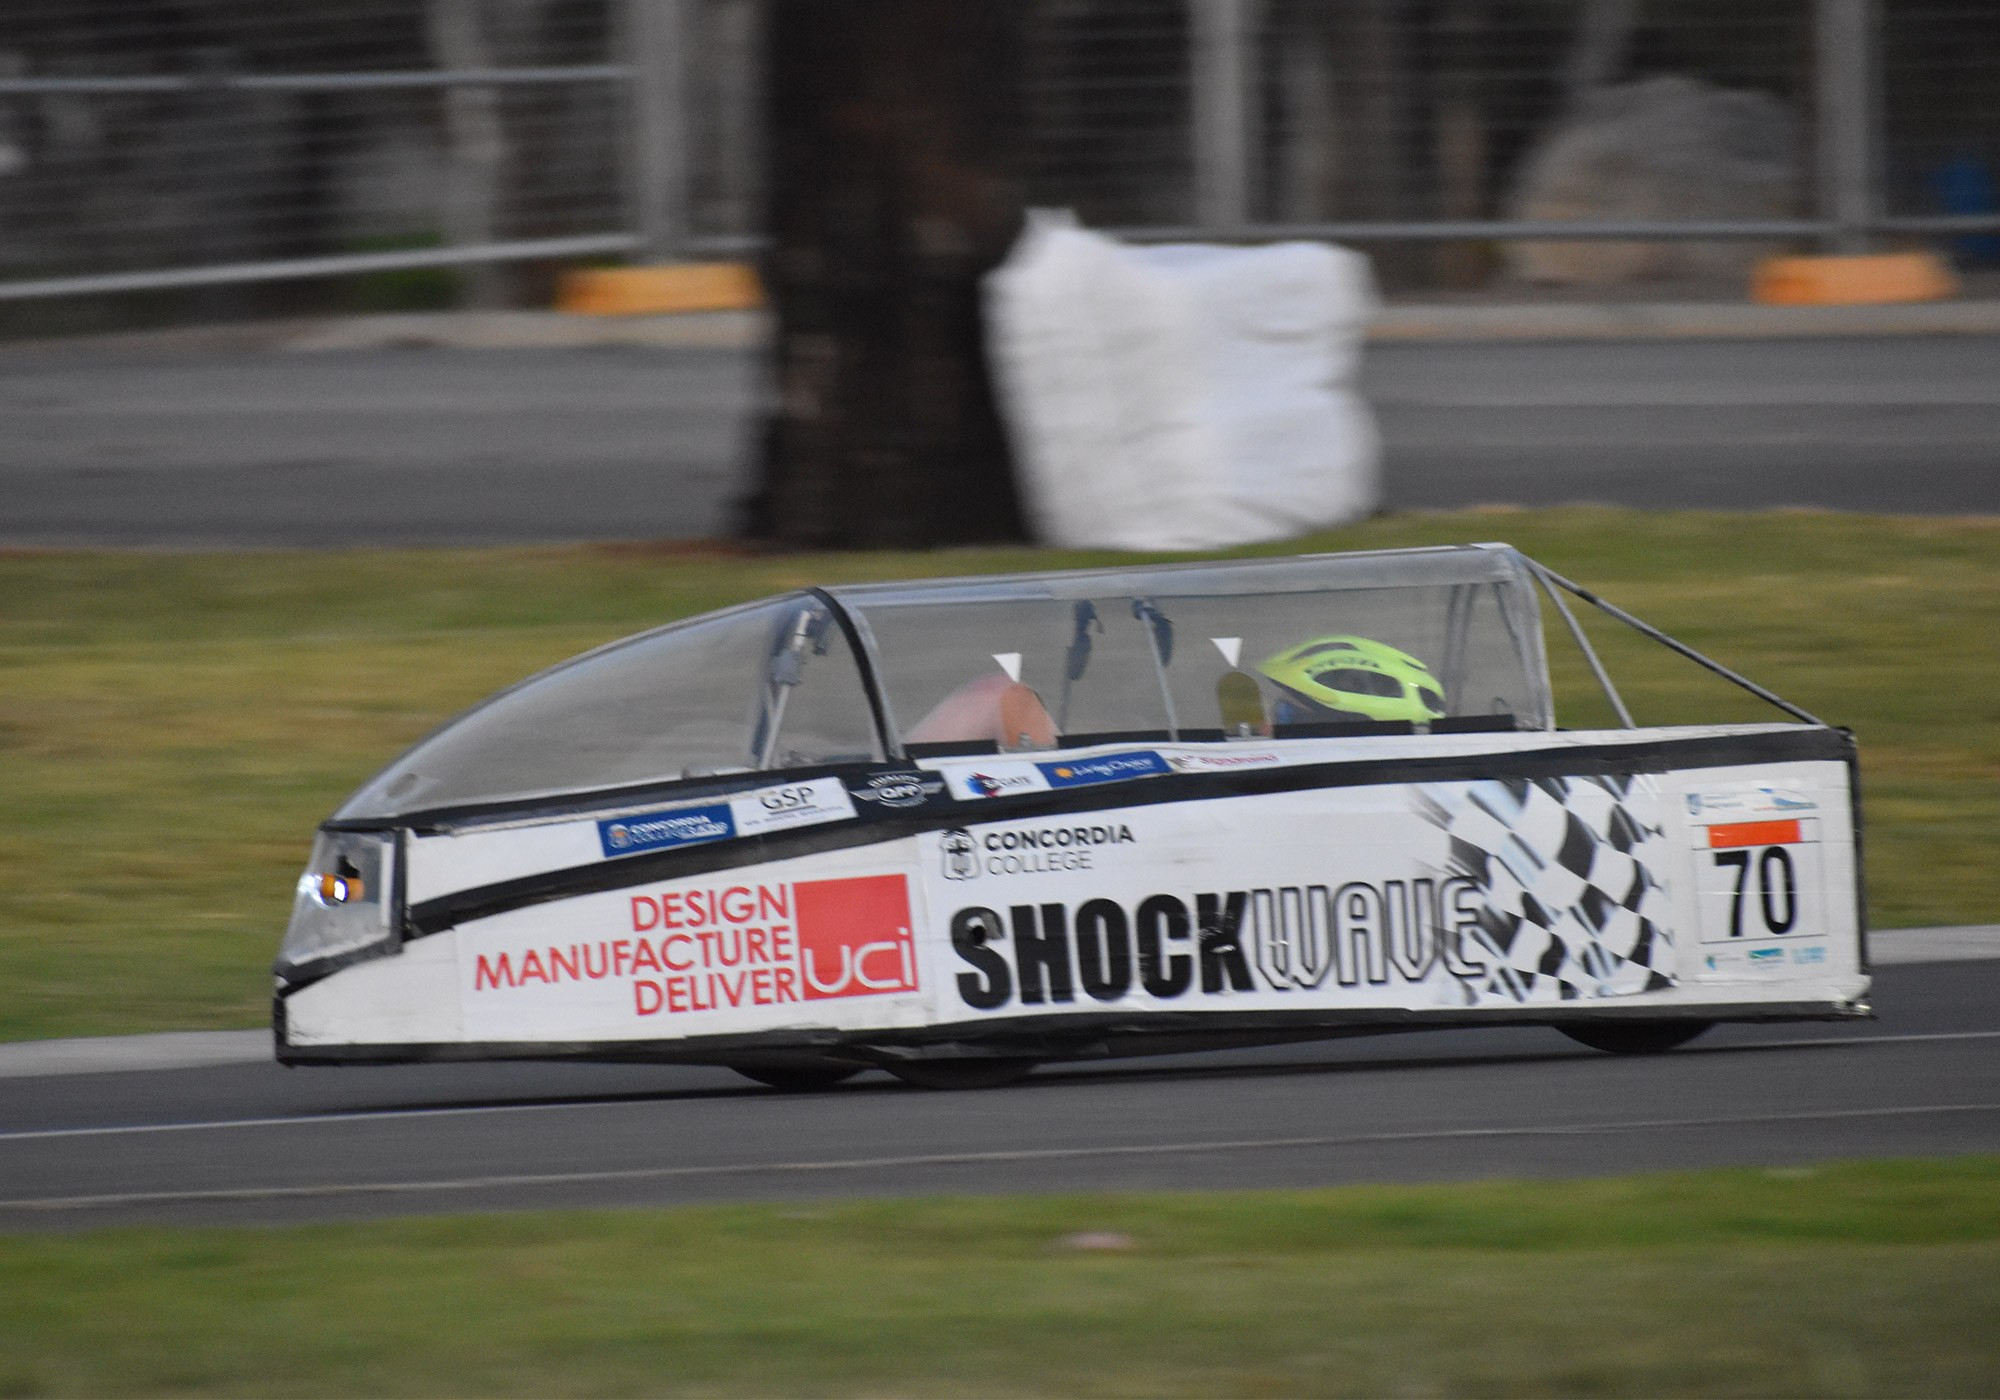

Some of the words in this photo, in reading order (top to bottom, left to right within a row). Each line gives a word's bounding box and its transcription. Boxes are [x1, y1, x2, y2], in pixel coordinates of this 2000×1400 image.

[760, 786, 815, 809] GSP
[984, 824, 1136, 852] CONCORDIA
[985, 850, 1094, 876] COLLEGE
[630, 882, 791, 932] DESIGN
[1713, 846, 1798, 938] 70
[474, 925, 794, 991] MANUFACTURE
[802, 926, 916, 994] uci
[634, 966, 800, 1016] DELIVER
